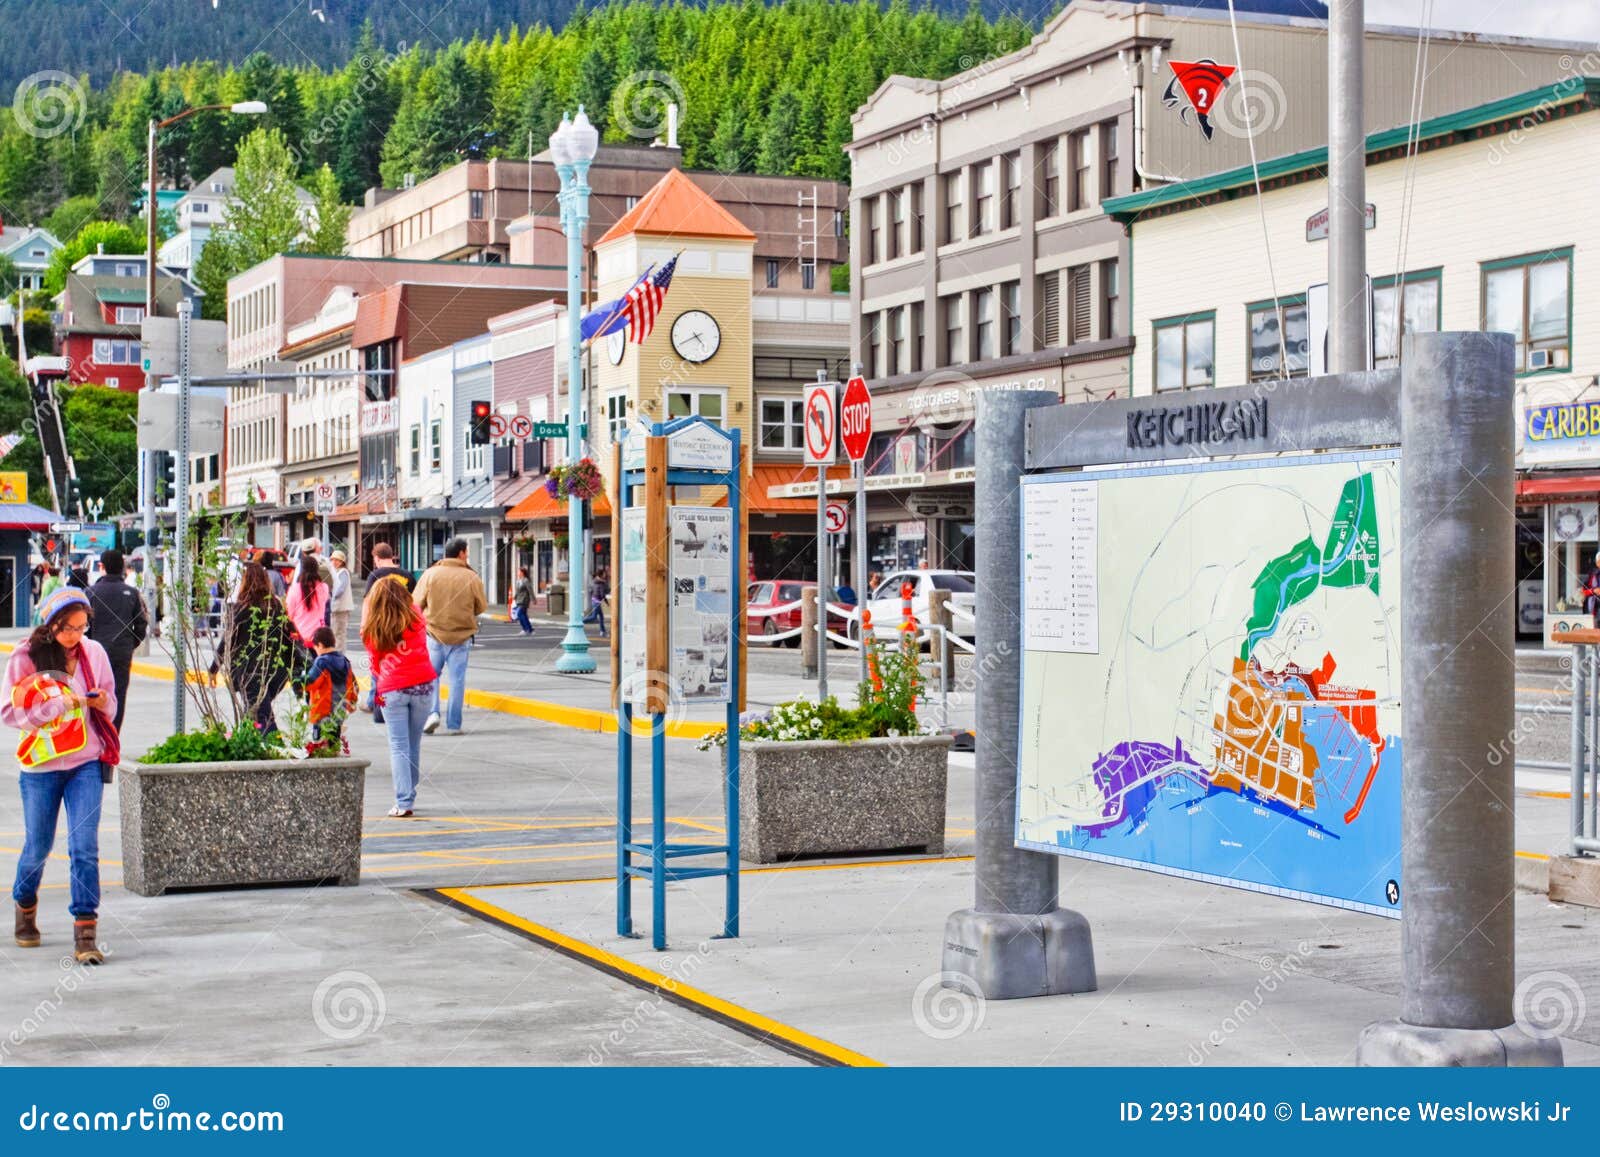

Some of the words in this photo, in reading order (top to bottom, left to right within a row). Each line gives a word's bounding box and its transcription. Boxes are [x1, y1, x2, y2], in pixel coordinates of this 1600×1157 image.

[1198, 87, 1208, 107] 2
[907, 388, 960, 409] TONGASS
[540, 426, 564, 435] Dock
[843, 402, 870, 437] STOP
[1127, 397, 1268, 449] KETCHIKAN
[1528, 404, 1600, 441] CARIBB
